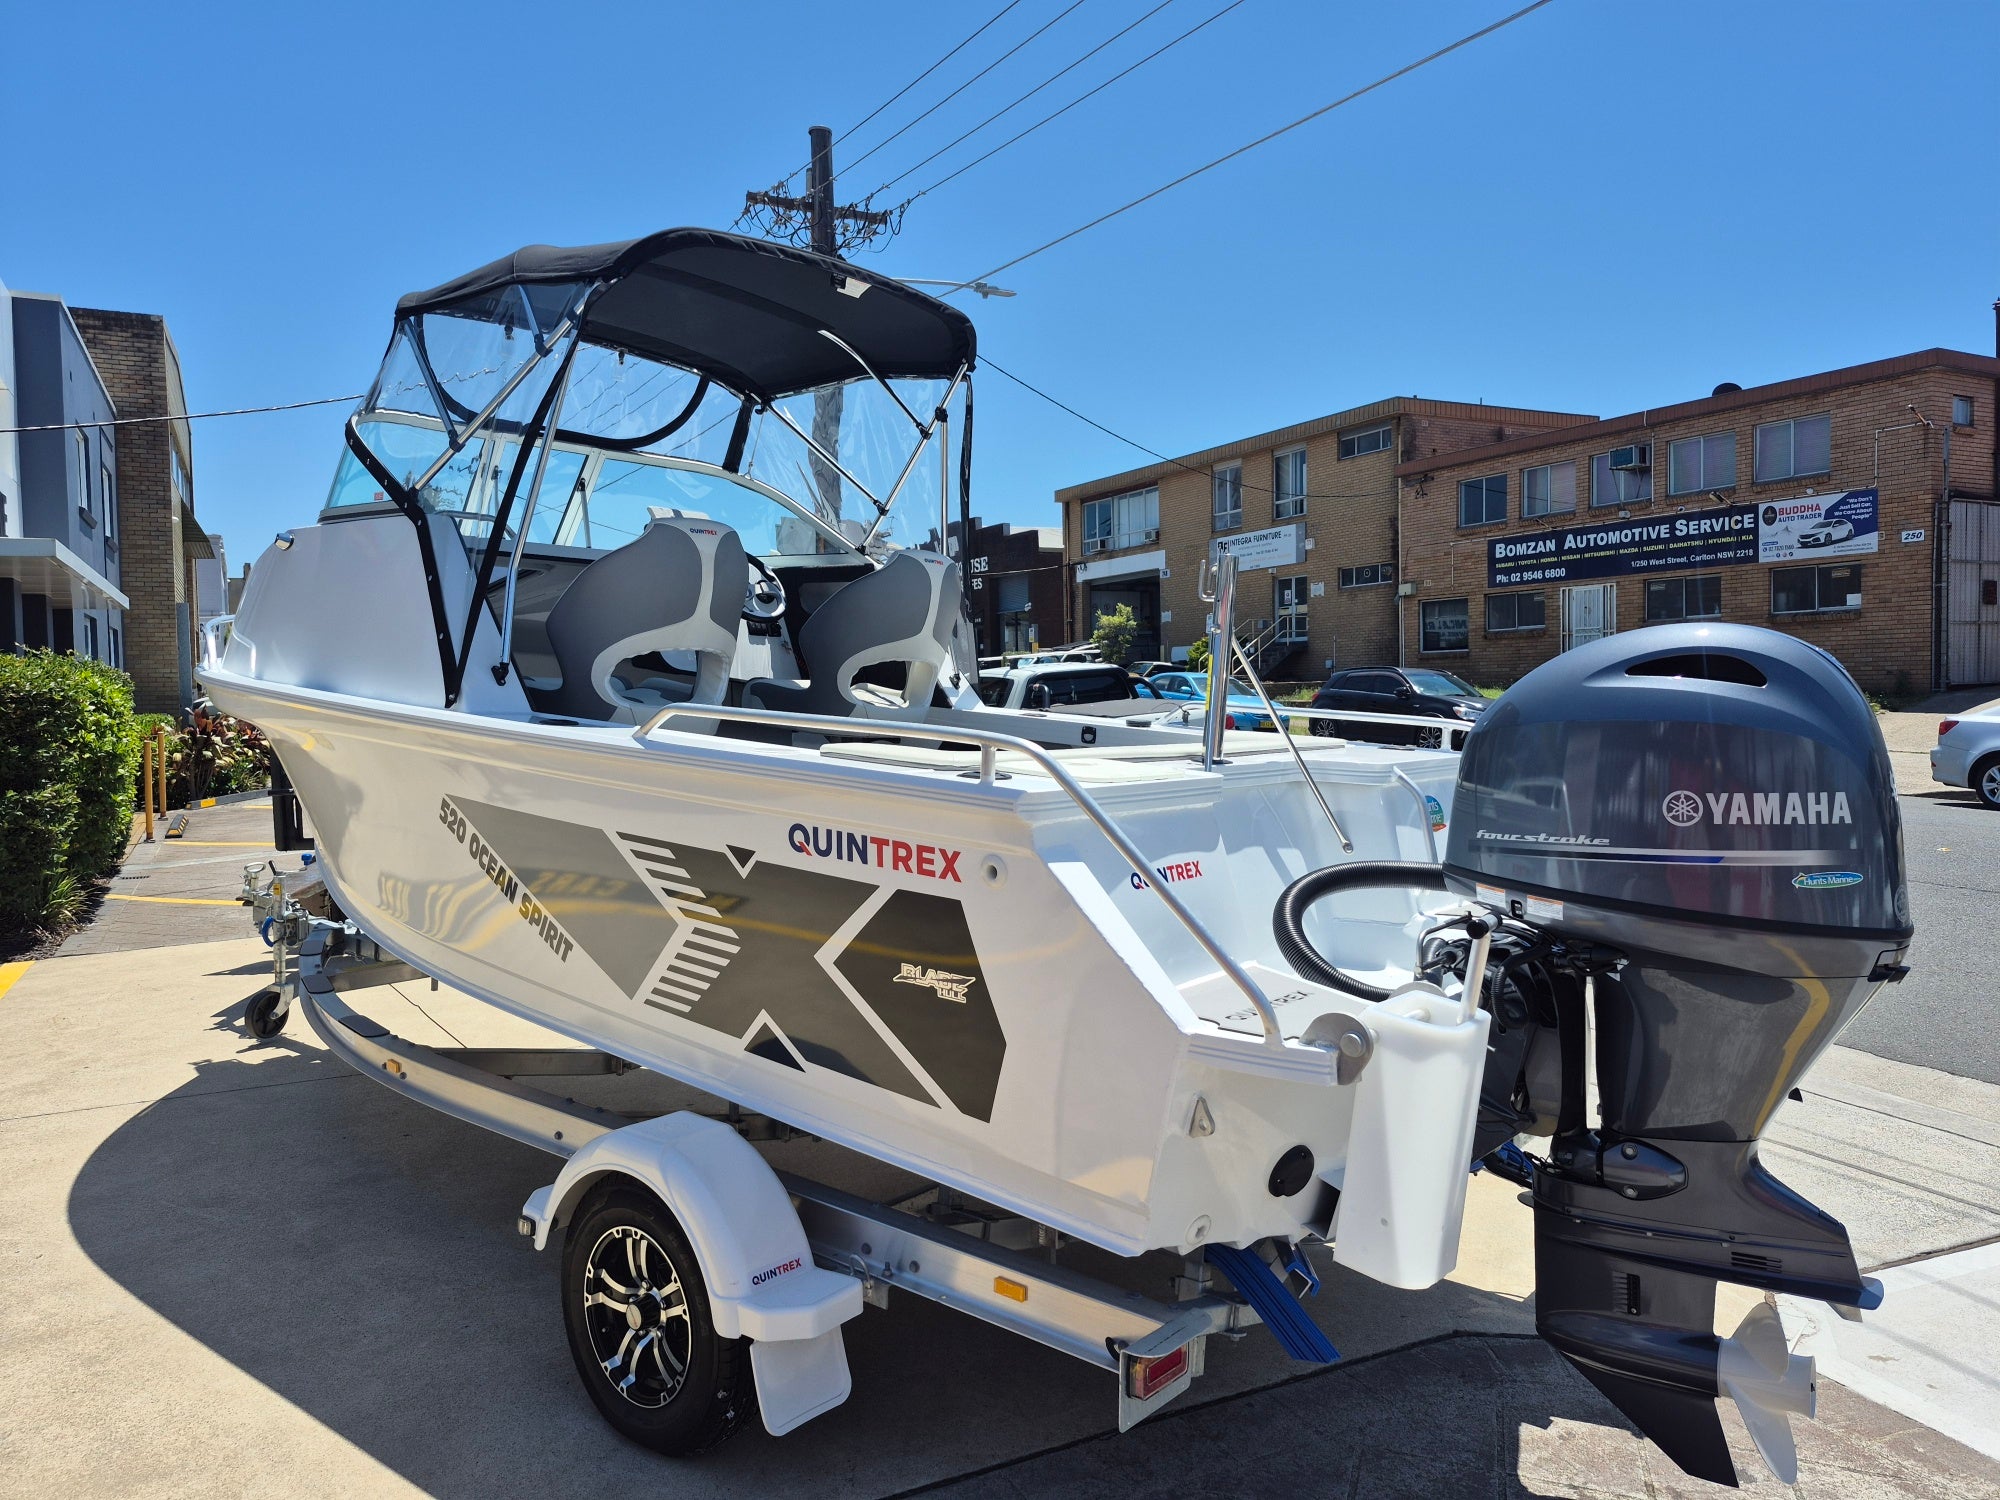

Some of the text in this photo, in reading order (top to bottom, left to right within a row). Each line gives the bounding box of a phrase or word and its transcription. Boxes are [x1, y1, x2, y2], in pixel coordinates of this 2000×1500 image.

[1778, 503, 1821, 516] BUDDHA
[1778, 515, 1795, 523] AUTO
[1797, 512, 1823, 521] TRADER
[1229, 536, 1252, 547] INTEGRA
[1253, 530, 1282, 541] FURNITURE
[1495, 513, 1755, 559] BOMZAN AUTOMOTIVE SERVICE
[1903, 531, 1923, 541] 250
[1495, 561, 1515, 569] SUBARU
[1584, 550, 1616, 558] MITSUBISHI
[1642, 544, 1665, 552] SUZUKI
[1708, 537, 1737, 545] HYUNDAI
[1631, 549, 1753, 568] 1/250 West Street, Carlton NSW 2218
[1496, 567, 1566, 583] Ph: 02 9546 6800
[1705, 790, 1853, 826] YAMAHA
[788, 822, 963, 884] QUINTREX
[439, 796, 574, 963] 520 OCEAN SPIRIT
[1130, 860, 1203, 890] QNTREX
[1804, 877, 1827, 886] Hunts
[898, 963, 972, 992] BLADE
[938, 987, 967, 1003] HULL
[751, 1257, 802, 1286] QUINTREX
